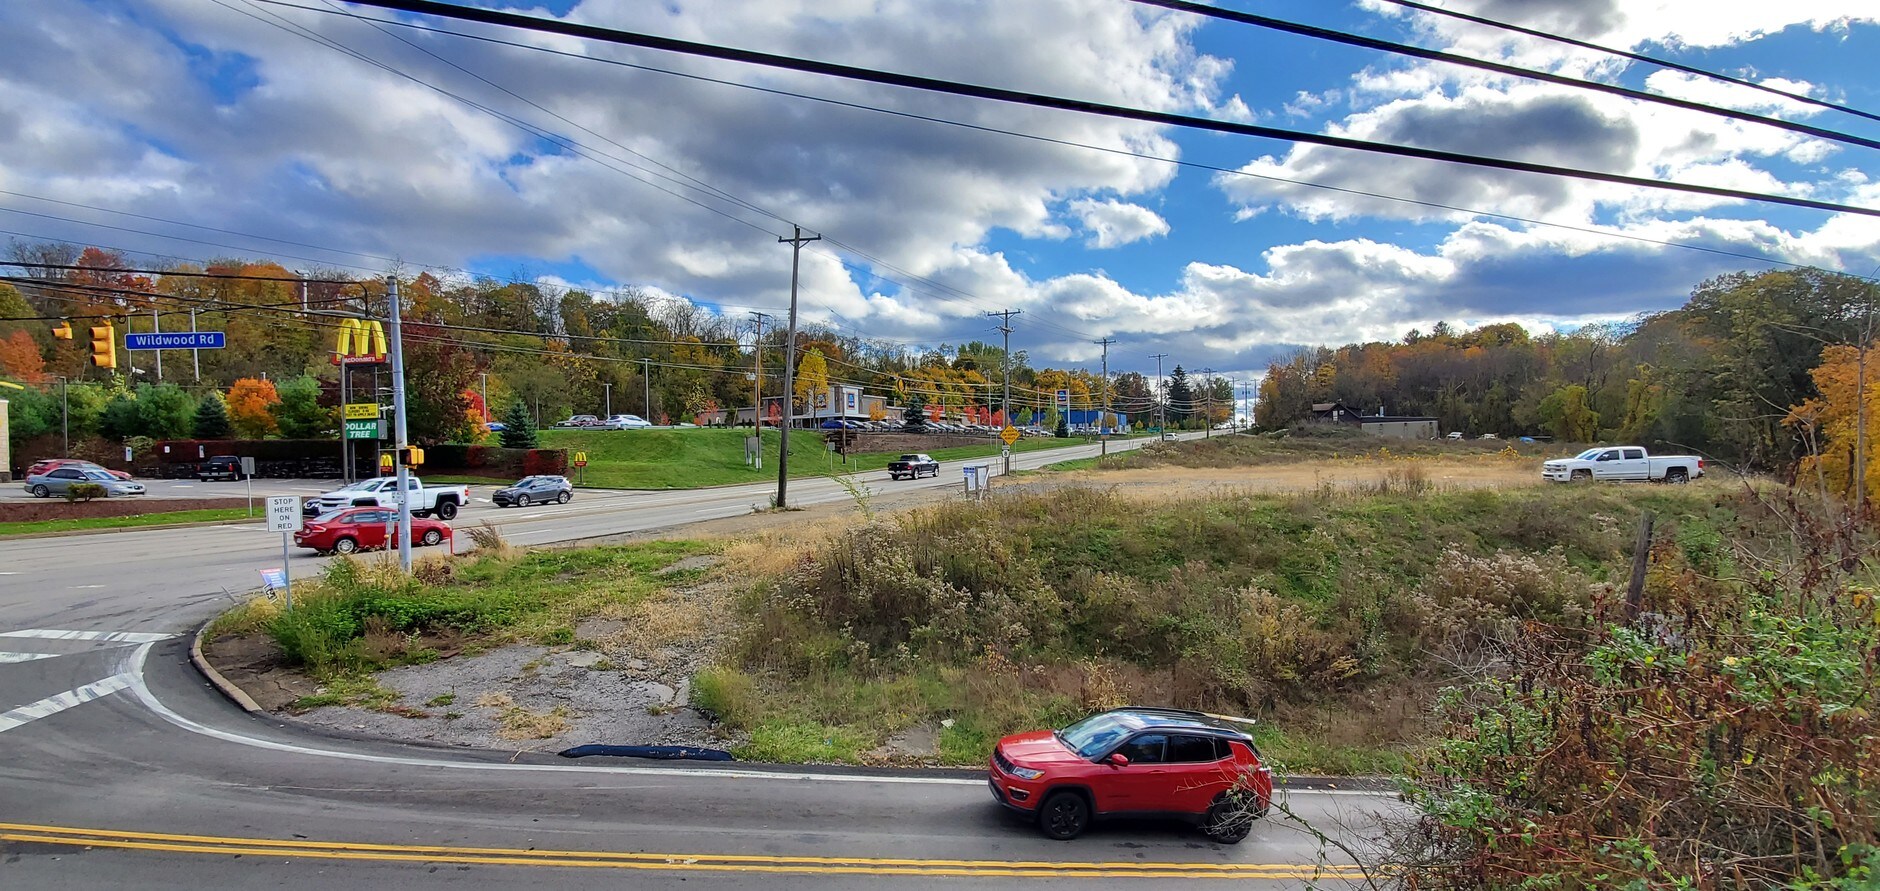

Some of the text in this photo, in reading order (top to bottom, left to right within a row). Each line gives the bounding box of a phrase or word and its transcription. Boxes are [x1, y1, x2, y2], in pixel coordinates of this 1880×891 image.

[136, 334, 214, 346] Wildwood Rd
[350, 430, 371, 438] TREE
[274, 506, 294, 514] HERE
